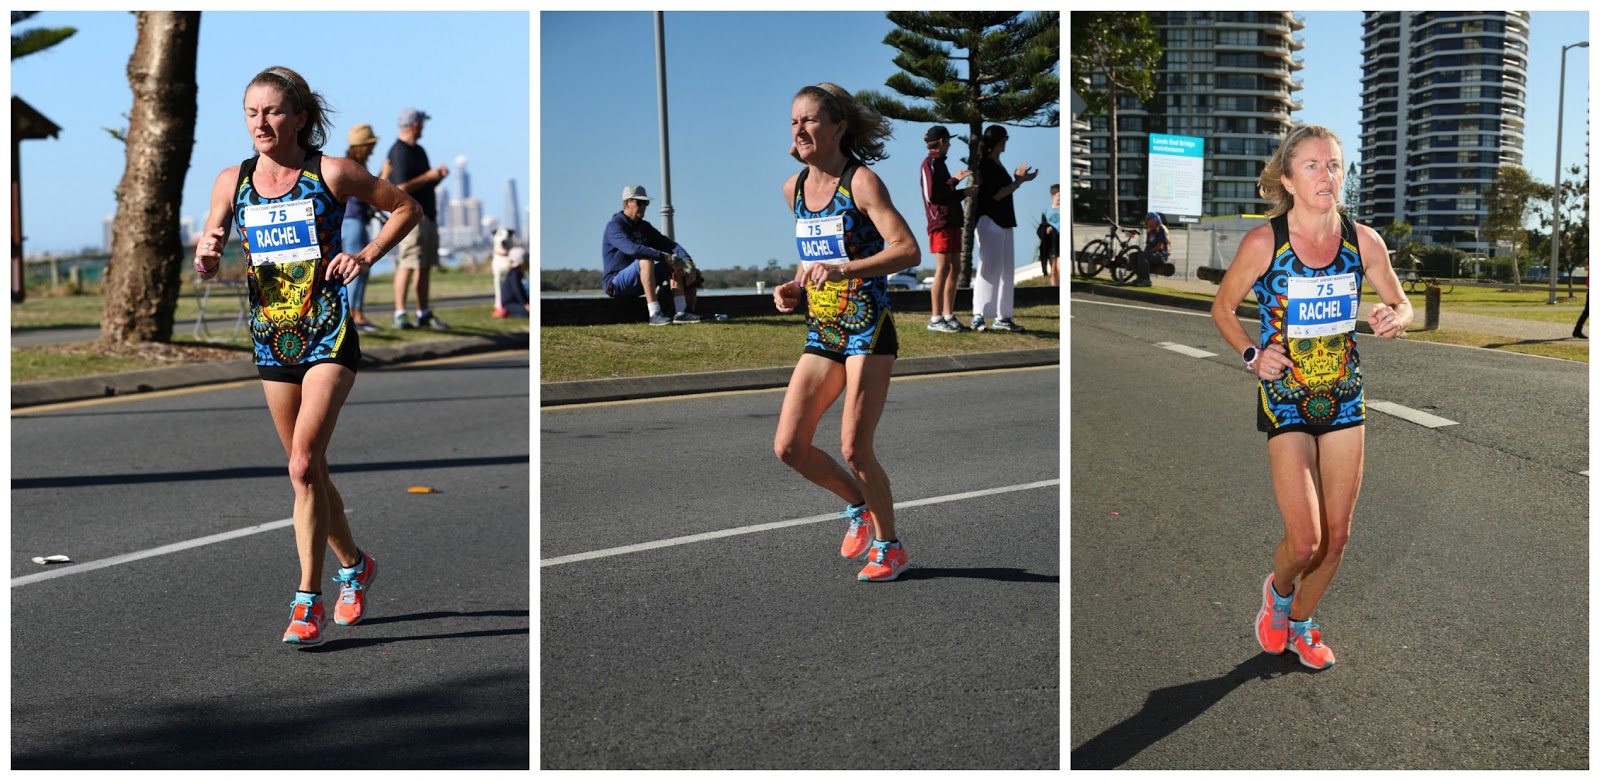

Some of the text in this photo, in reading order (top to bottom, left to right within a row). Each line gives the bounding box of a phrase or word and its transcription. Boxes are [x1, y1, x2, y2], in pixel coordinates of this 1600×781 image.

[1153, 145, 1185, 153] maintenance
[1179, 140, 1195, 148] Bridge
[268, 209, 287, 223] 75
[808, 225, 821, 235] 75
[256, 226, 300, 248] RACHEL
[801, 239, 833, 256] RACHEL
[1317, 283, 1334, 296] 75
[1299, 300, 1342, 320] RACHEL
